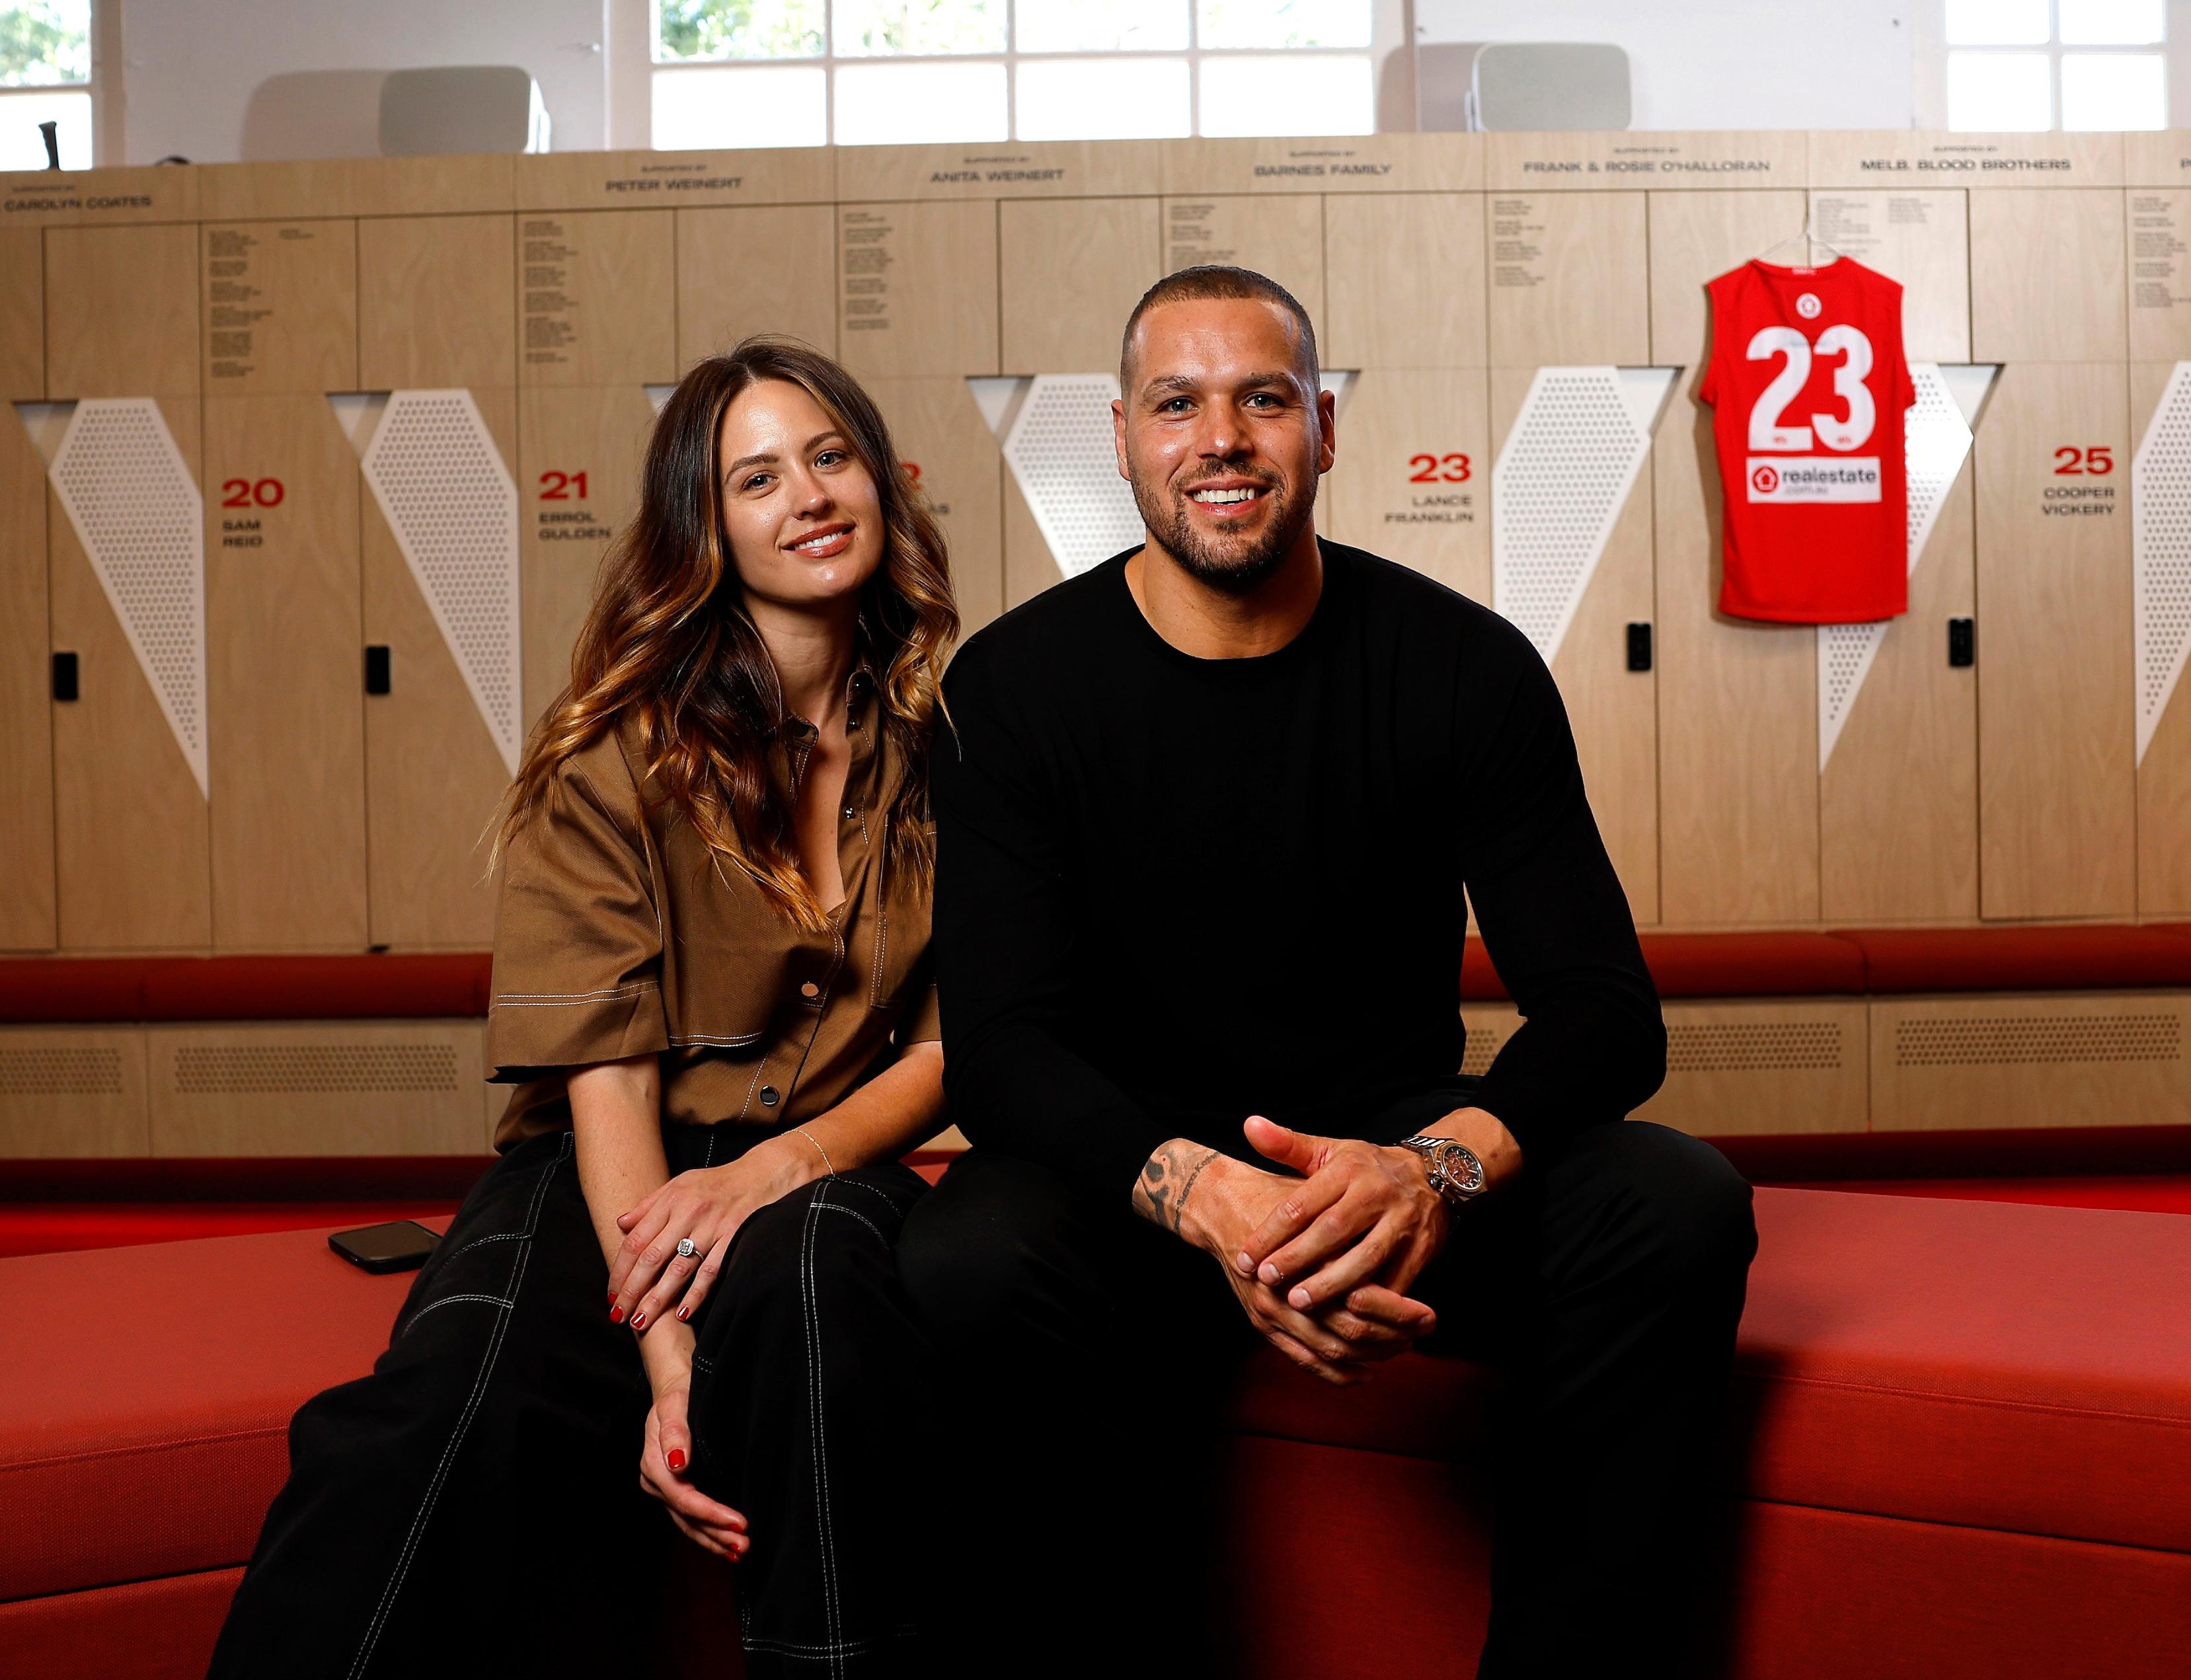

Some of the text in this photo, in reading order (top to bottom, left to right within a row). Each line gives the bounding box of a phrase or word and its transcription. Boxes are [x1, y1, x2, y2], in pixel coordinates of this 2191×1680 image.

[1254, 164, 1391, 176] BARNES FAMILY
[1523, 161, 1771, 172] FRANK & ROSIE O'HALLORAN
[1861, 159, 2071, 171] MELB. BLOOD BROTHERS
[931, 169, 1065, 182] ANITA WEINERT
[605, 176, 742, 192] PETER WEINERT
[4, 195, 152, 212] CAROLYN COATES
[1746, 324, 1876, 451] 23
[2054, 445, 2114, 476] 25
[1409, 452, 1471, 483] 23
[1783, 467, 1876, 483] realestate
[539, 471, 588, 500] 21
[221, 478, 284, 508] 20
[2044, 487, 2115, 499] COOPER
[1412, 496, 1472, 506] LANCE
[2042, 504, 2115, 515] VICKERY
[539, 512, 596, 523] ERROL
[1385, 512, 1474, 523] FRANKLIN
[222, 519, 261, 531] SAM
[539, 527, 611, 540] GULDEN
[222, 536, 262, 548] REID
